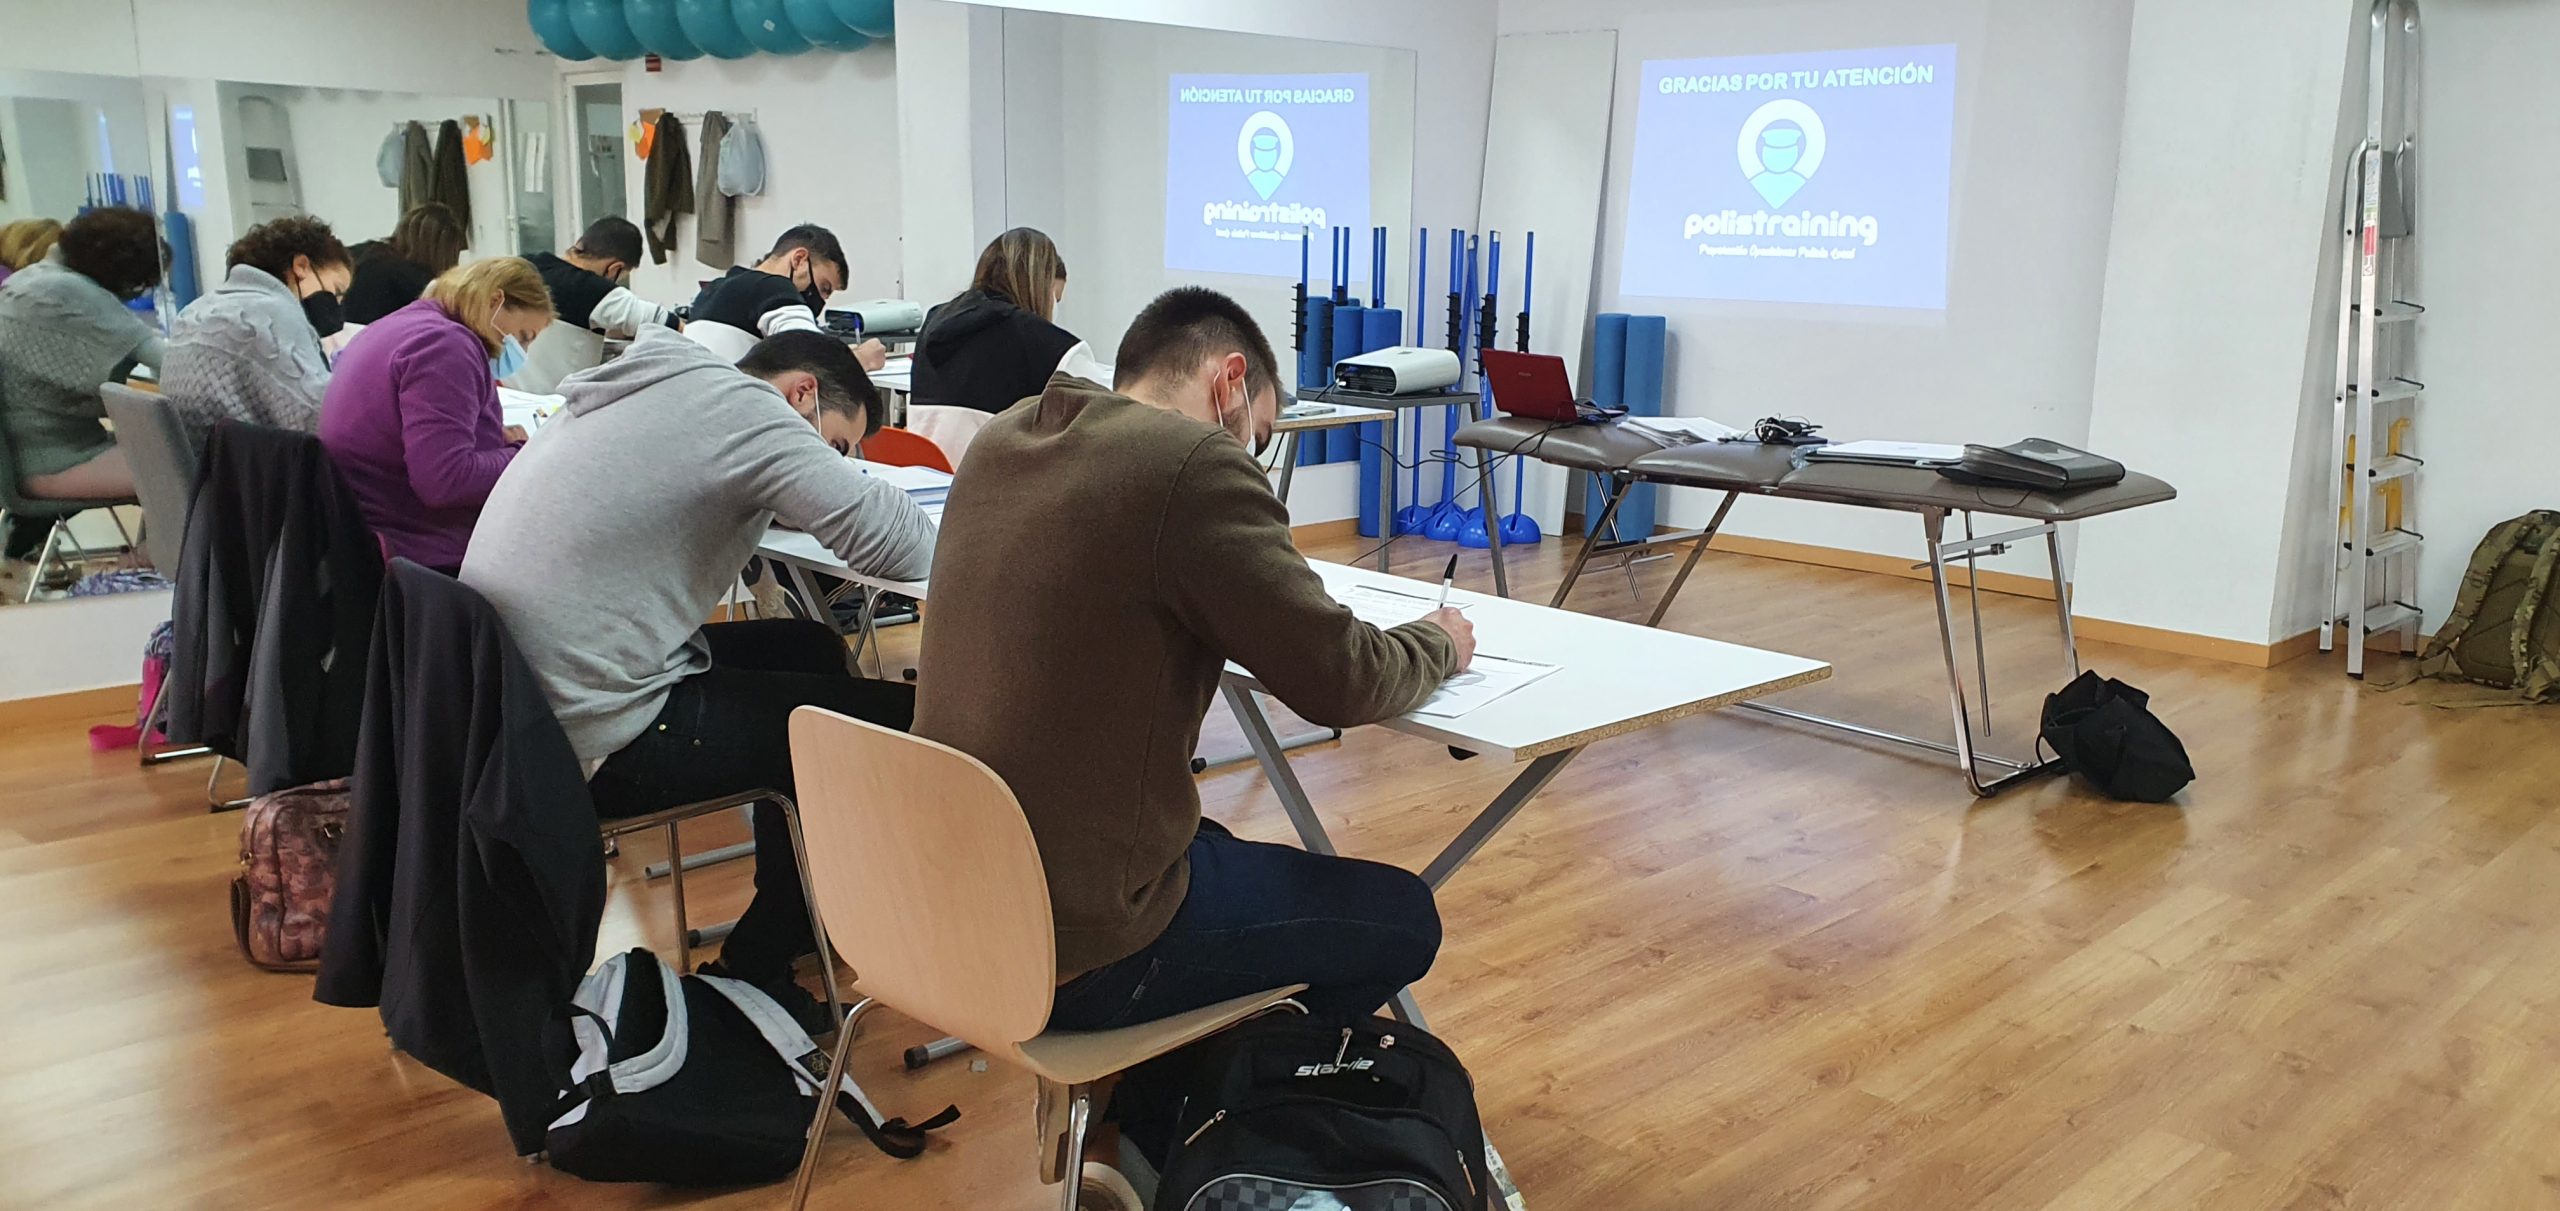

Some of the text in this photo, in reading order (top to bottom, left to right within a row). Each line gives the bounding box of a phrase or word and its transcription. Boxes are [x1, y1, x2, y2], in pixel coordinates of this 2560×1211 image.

[1658, 62, 1934, 94] GRACIAS POR TU ATENCIÓN
[1684, 209, 1879, 246] polistraining
